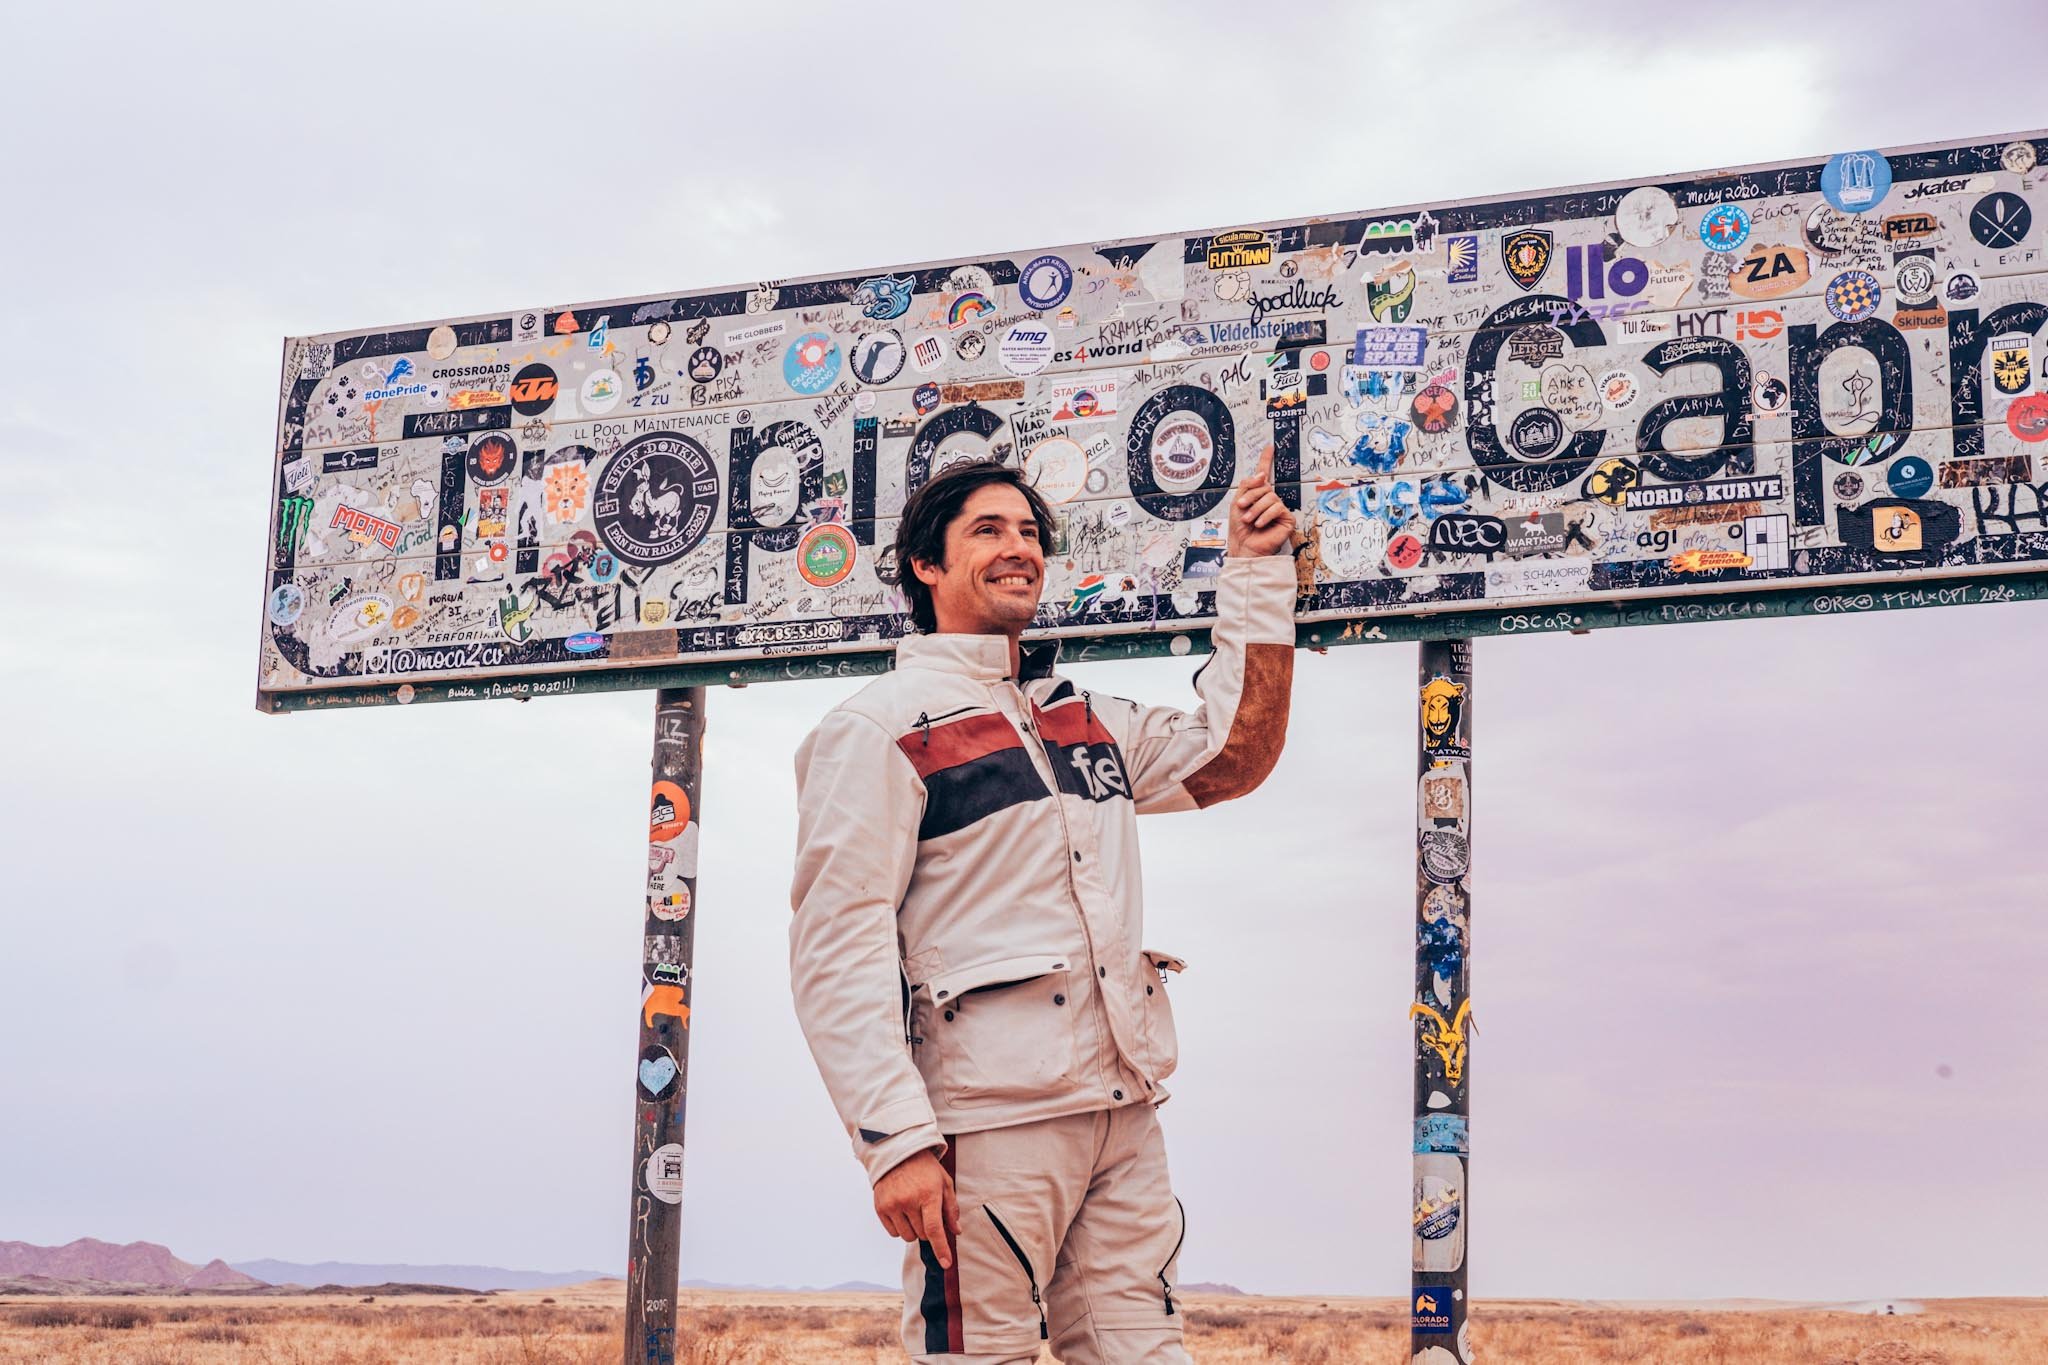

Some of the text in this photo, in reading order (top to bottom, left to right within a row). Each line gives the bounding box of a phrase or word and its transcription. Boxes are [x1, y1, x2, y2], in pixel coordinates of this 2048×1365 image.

[1886, 217, 1937, 241] PETZL
[1741, 252, 1796, 283] ZA
[1846, 271, 1879, 290] VIGOR
[1842, 304, 1875, 322] FLAMINIO
[1622, 320, 1638, 334] TUI
[728, 334, 743, 342] THE
[1008, 329, 1049, 345] hmg
[1993, 339, 2028, 350] ARNHEM
[432, 364, 511, 379] CROSSROADS
[1270, 371, 1304, 391] Fuel
[364, 384, 427, 400] #OnePride
[510, 377, 559, 403] KTM
[634, 412, 730, 434] MAINTENANCE
[697, 482, 714, 493] VAS
[1627, 480, 1782, 508] NORD KURVE
[331, 504, 401, 550] MOTO
[627, 542, 650, 557] FUN
[651, 537, 685, 557] RALLY
[1507, 535, 1564, 548] WARTHOG
[1451, 643, 1472, 653] TEA
[1412, 1315, 1449, 1323] OLORADO
